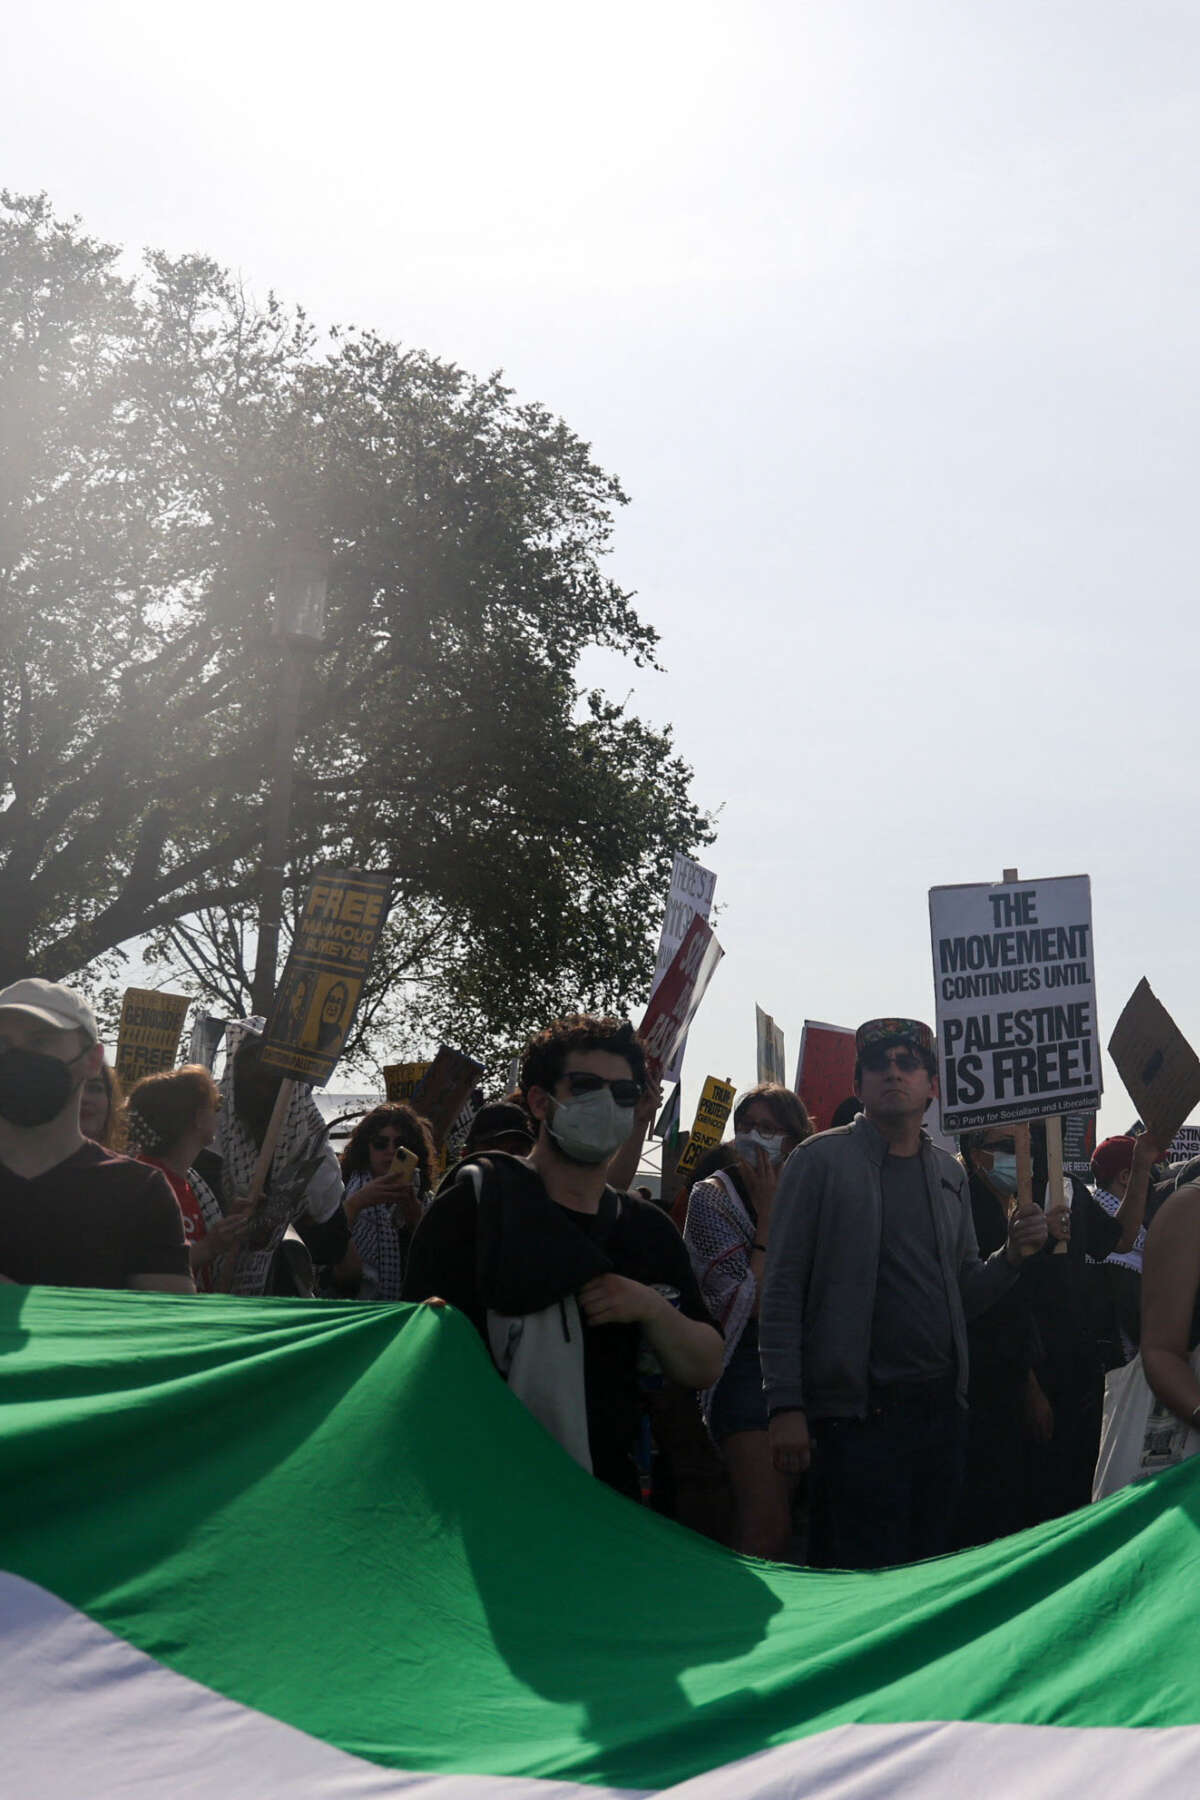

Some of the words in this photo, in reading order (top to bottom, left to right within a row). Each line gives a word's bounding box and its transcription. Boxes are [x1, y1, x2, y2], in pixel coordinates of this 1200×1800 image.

[307, 885, 385, 926] FREE
[989, 891, 1037, 928] THE
[302, 919, 375, 945] MAHMOUD
[939, 924, 1090, 974] MOVEMENT
[942, 967, 1041, 1001] CONTINUES
[1044, 962, 1091, 987] UNTIL
[943, 1002, 1091, 1056] PALESTINE
[121, 1044, 173, 1066] FREE
[947, 1055, 984, 1107] IS
[992, 1039, 1093, 1100] FREE!
[962, 1111, 987, 1127] Party
[987, 1108, 1000, 1122] for
[1001, 1103, 1041, 1119] Socialism
[1042, 1100, 1057, 1113] and
[1058, 1094, 1099, 1111] Liberation
